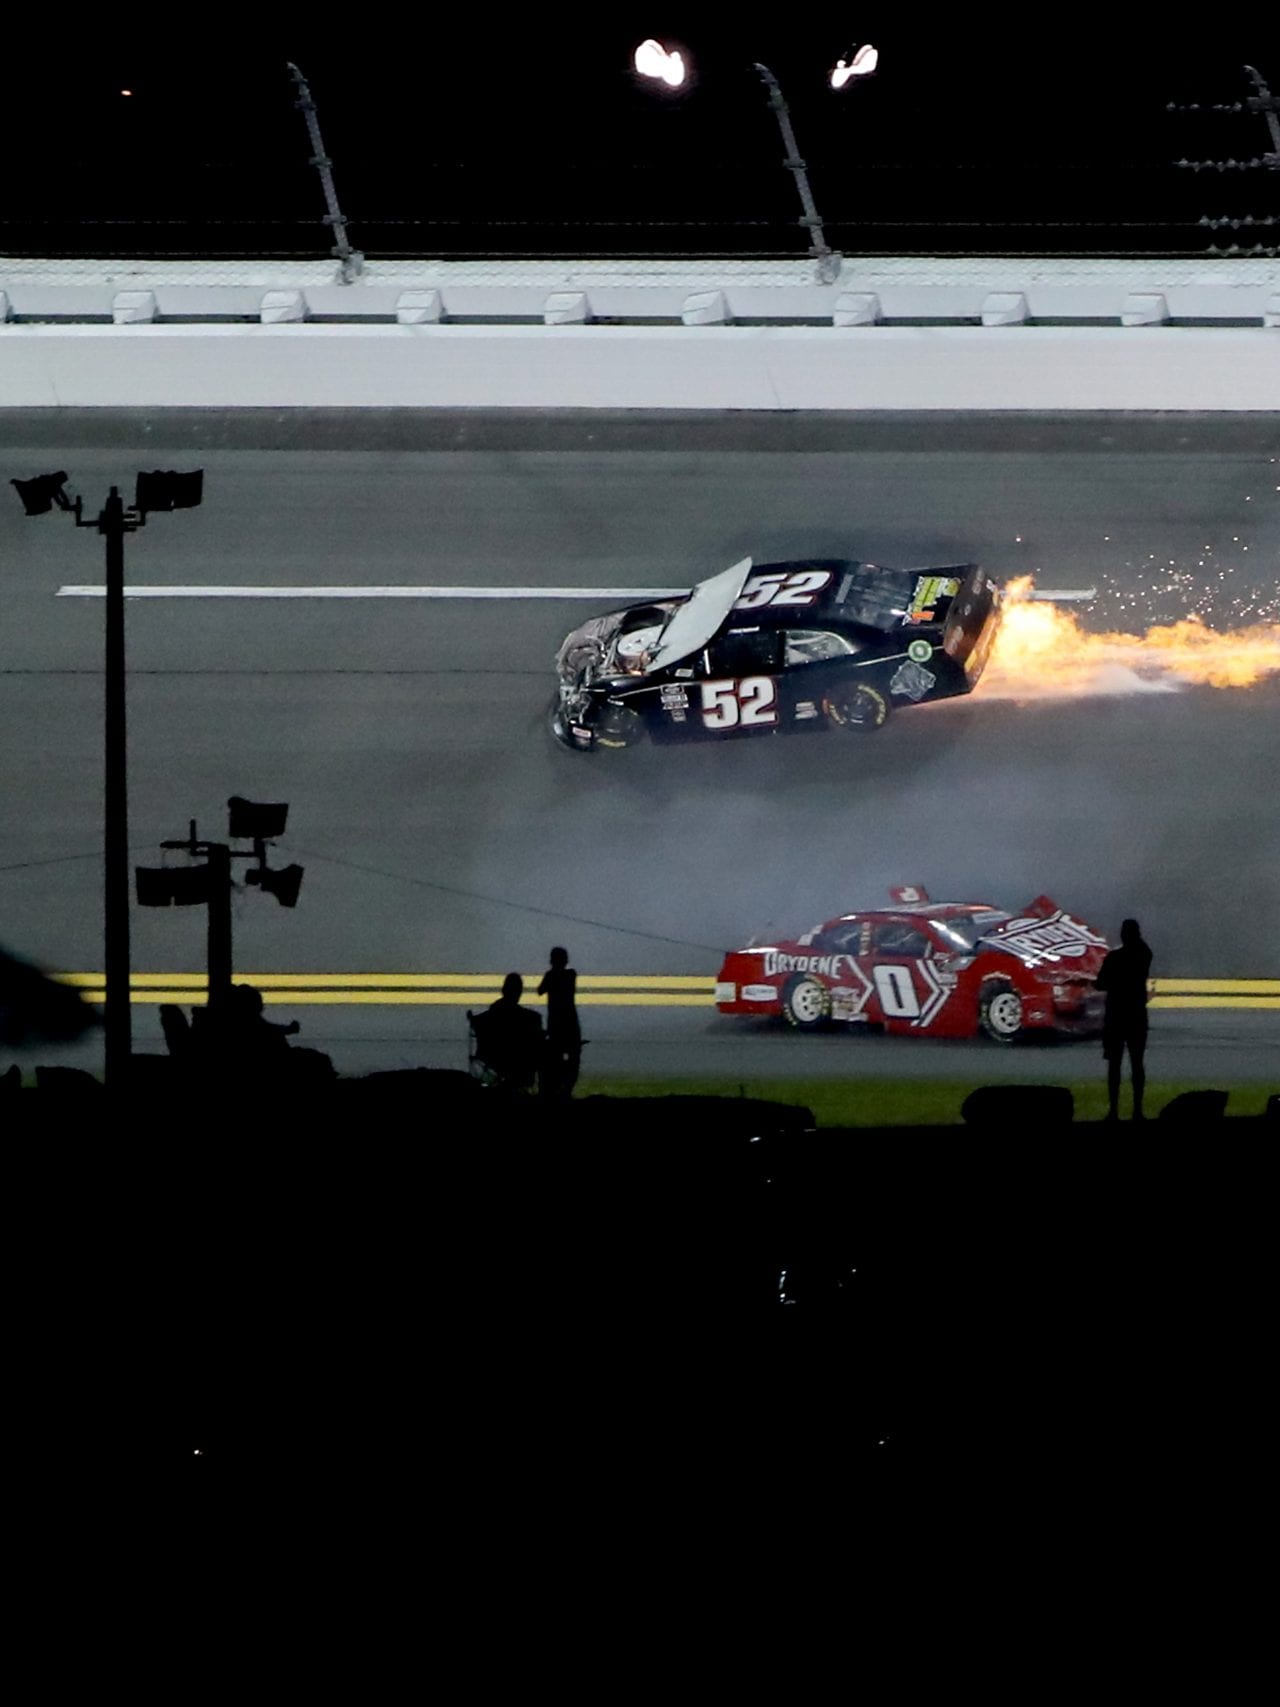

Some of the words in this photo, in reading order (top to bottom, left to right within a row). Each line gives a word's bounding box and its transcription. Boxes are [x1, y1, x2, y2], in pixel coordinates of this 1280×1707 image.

[733, 571, 831, 609] 52
[702, 676, 776, 728] 52
[764, 951, 842, 979] DRYDENE
[873, 964, 921, 1018] 0
